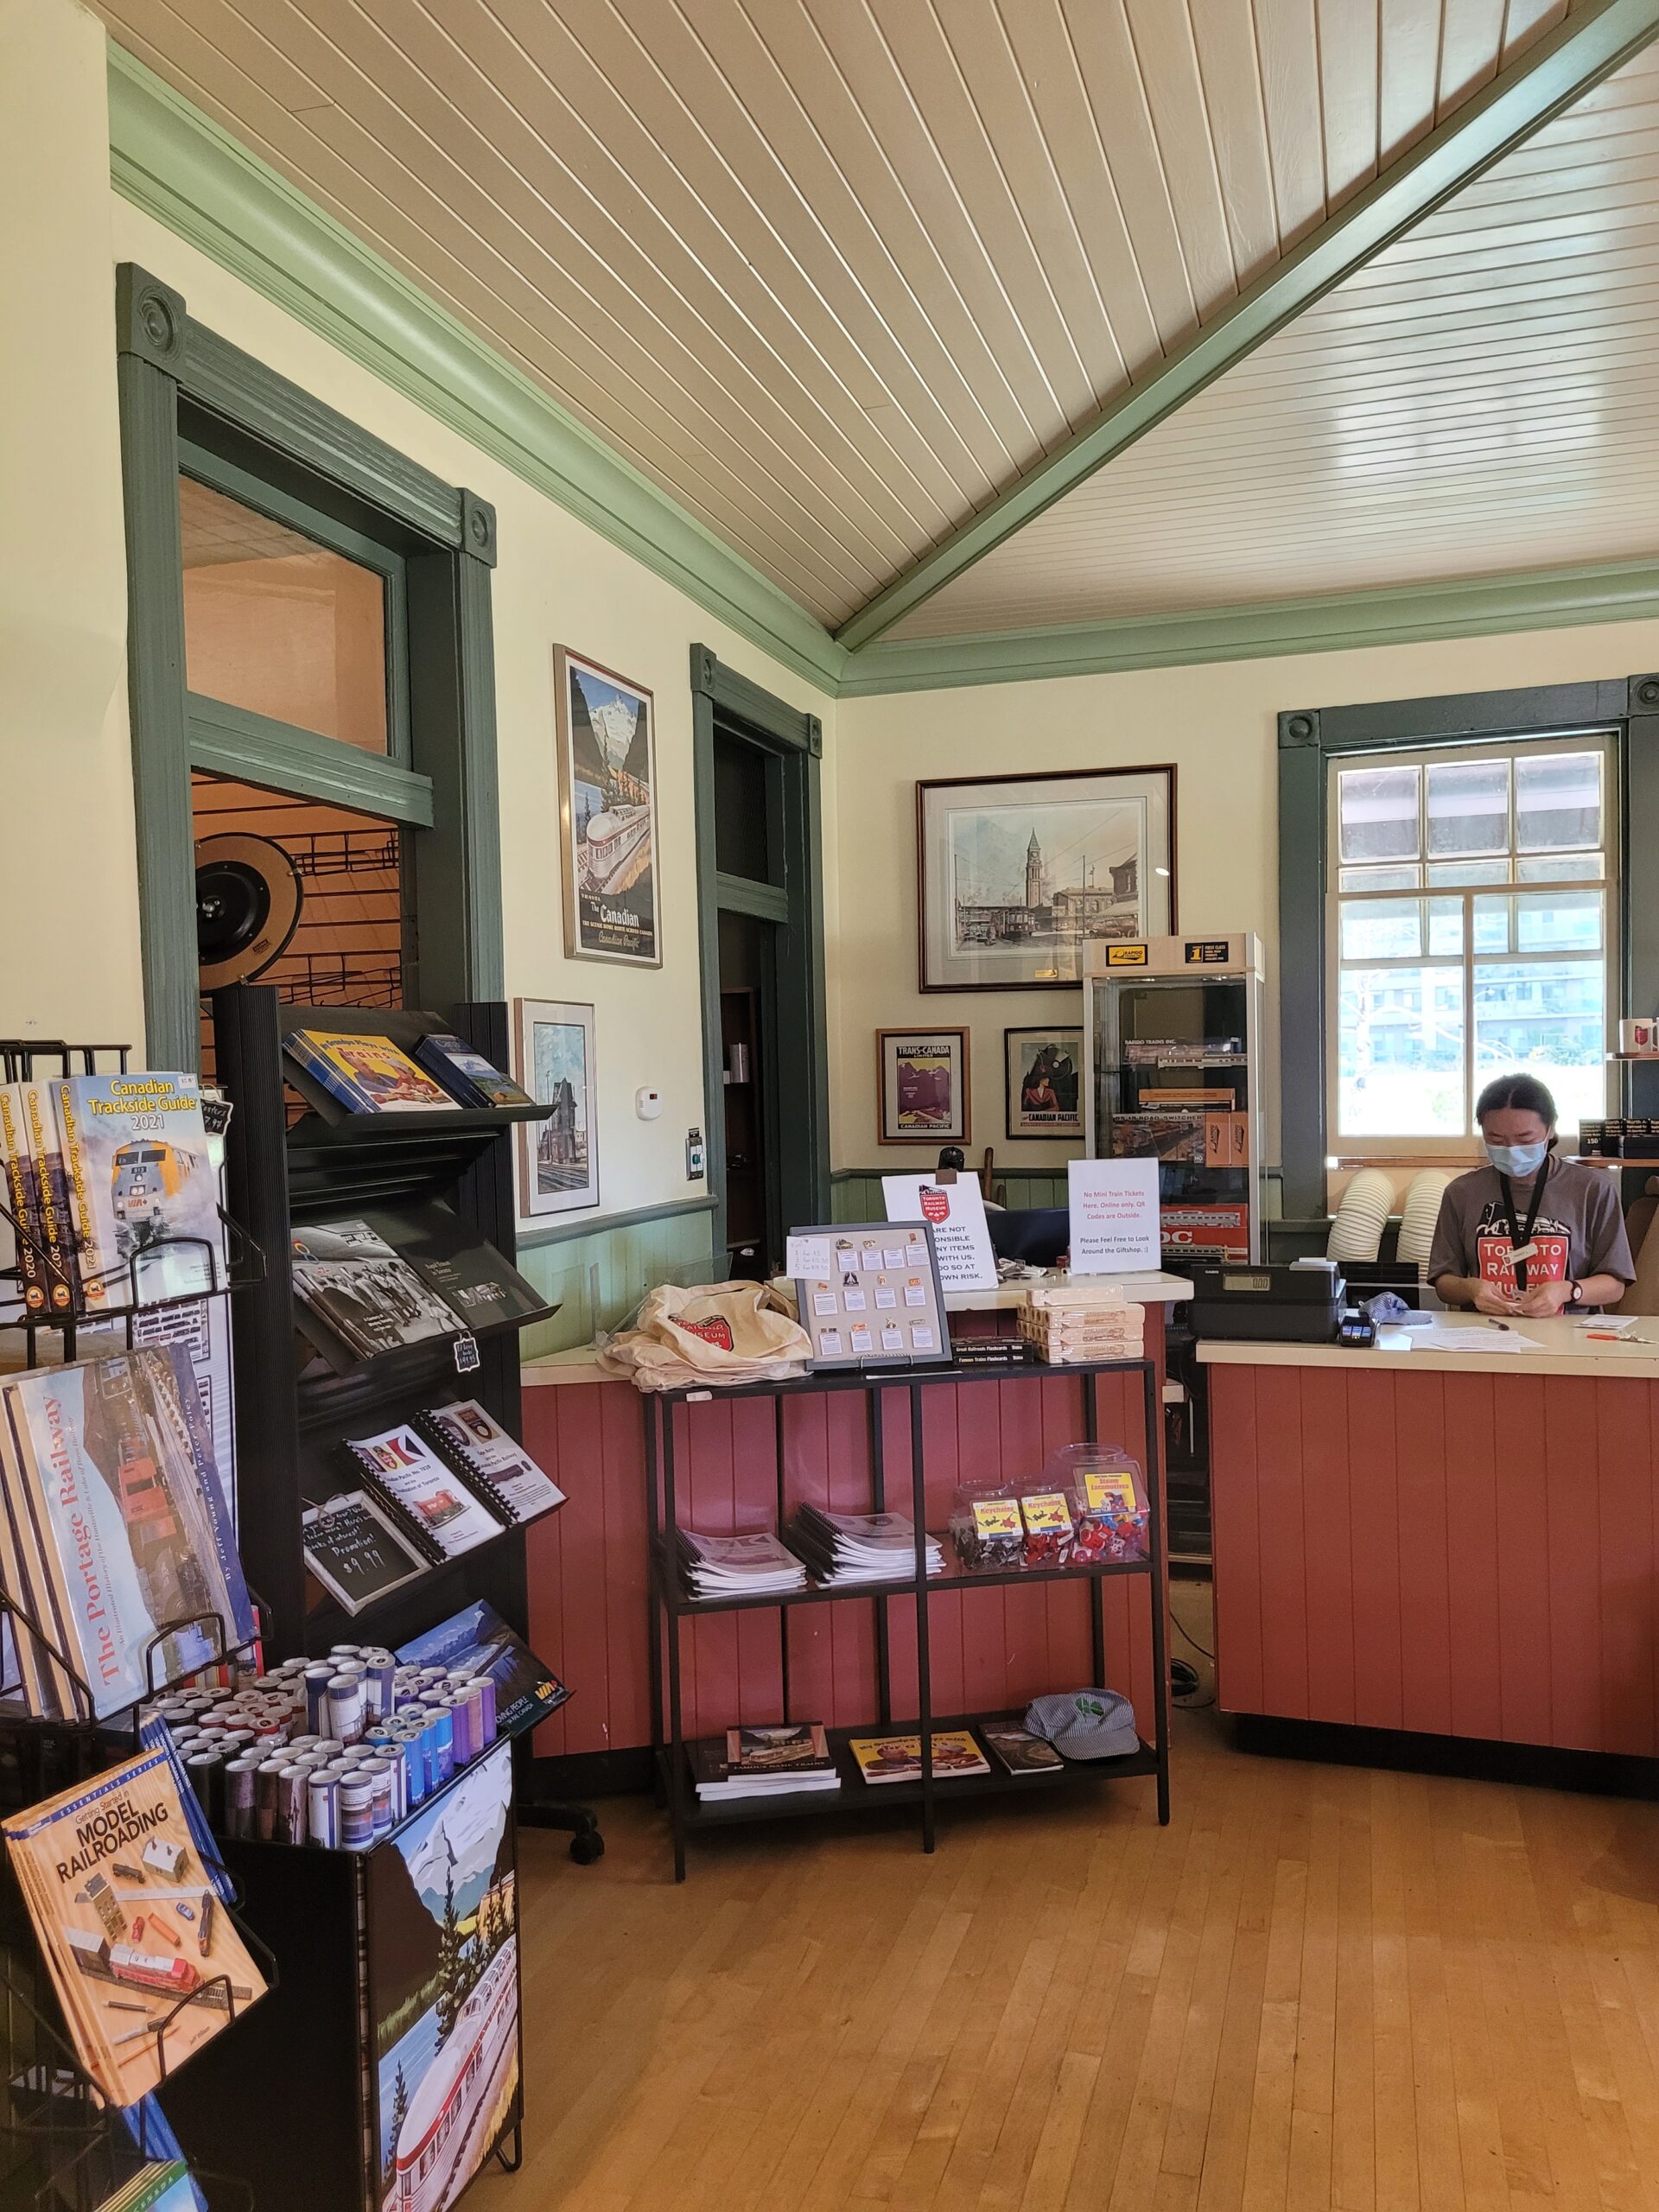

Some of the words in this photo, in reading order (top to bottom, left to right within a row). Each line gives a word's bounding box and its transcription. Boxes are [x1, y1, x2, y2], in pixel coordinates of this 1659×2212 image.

[590, 901, 599, 912] The
[600, 904, 639, 927] Canadian
[336, 1046, 391, 1059] Trains
[110, 1078, 175, 1096] Canadian
[29, 1090, 42, 1147] Canadian
[60, 1085, 76, 1142] Canadian
[88, 1096, 156, 1116] Trackside
[157, 1094, 195, 1111] Guide
[131, 1114, 164, 1130] 2021
[1, 1093, 16, 1150] Canadian
[9, 1150, 25, 1206] Trackside
[23, 1248, 36, 1278] 2020
[37, 1147, 53, 1205] Trackside
[69, 1142, 86, 1199] Trackside
[45, 1206, 58, 1243] Guide
[79, 1202, 91, 1238] Guide
[50, 1245, 62, 1275] 202
[84, 1241, 96, 1269] 2021
[1484, 1243, 1561, 1256] TORTO
[1487, 1262, 1559, 1276] RAIWAY
[43, 1396, 79, 1507] Railway
[194, 1435, 204, 1466] Peter
[200, 1471, 211, 1492] and
[207, 1497, 219, 1534] Young
[981, 1505, 1014, 1515] Keychains
[1027, 1499, 1061, 1509] Keychains
[216, 1537, 226, 1561] Jeff
[332, 1533, 376, 1557] Promotion!
[71, 1513, 106, 1622] Portage
[104, 1565, 112, 1596] History
[225, 1567, 232, 1580] By
[98, 1627, 119, 1687] The
[535, 1681, 556, 1700] VIA
[495, 1706, 513, 1724] OVING
[511, 1696, 529, 1713] PEOPLE
[165, 1727, 176, 1751] TORONTO
[60, 1779, 121, 1816] ESSENTIALS
[126, 1758, 159, 1780] SERIES
[75, 1807, 100, 1824] Getting
[99, 1794, 123, 1811] Started
[124, 1789, 130, 1799] in
[76, 1800, 139, 1847] MODEL
[56, 1802, 168, 1884] RAILROADING
